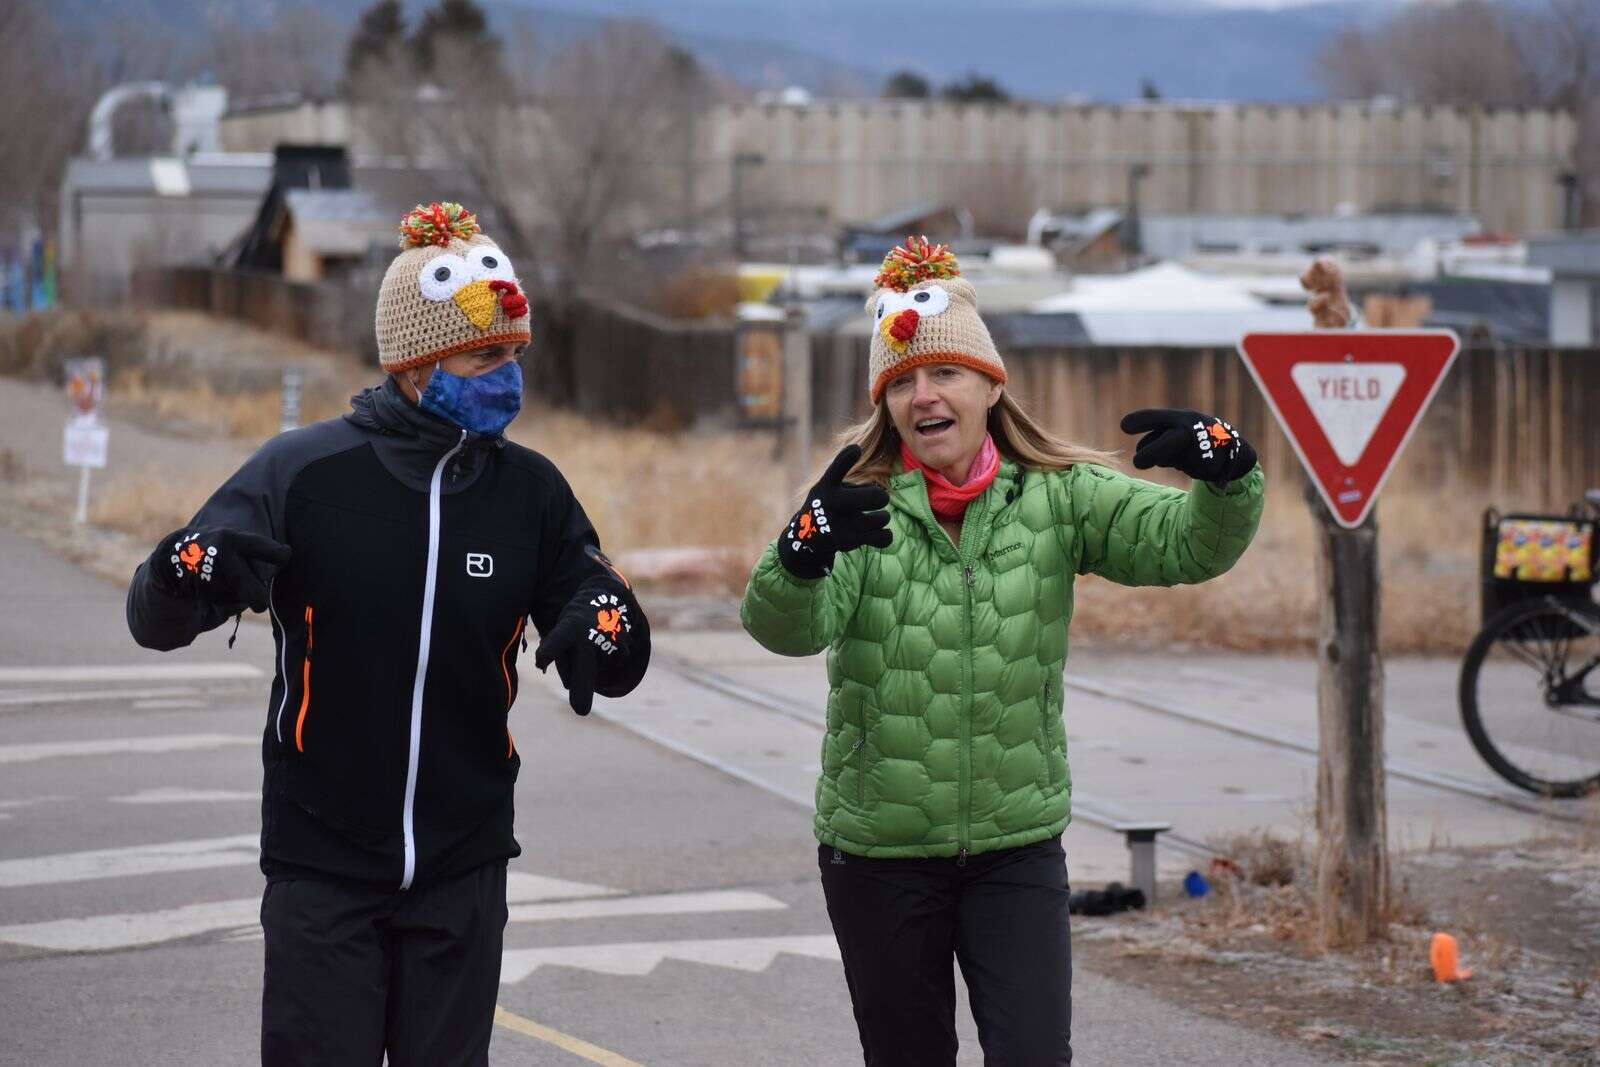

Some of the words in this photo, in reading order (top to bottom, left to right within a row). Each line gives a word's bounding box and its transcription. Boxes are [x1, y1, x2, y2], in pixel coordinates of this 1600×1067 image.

[1317, 376, 1381, 401] YIELD
[1193, 421, 1214, 459] TROT
[811, 498, 831, 534] 2020
[200, 546, 218, 582] 2020
[588, 628, 618, 655] TROT
